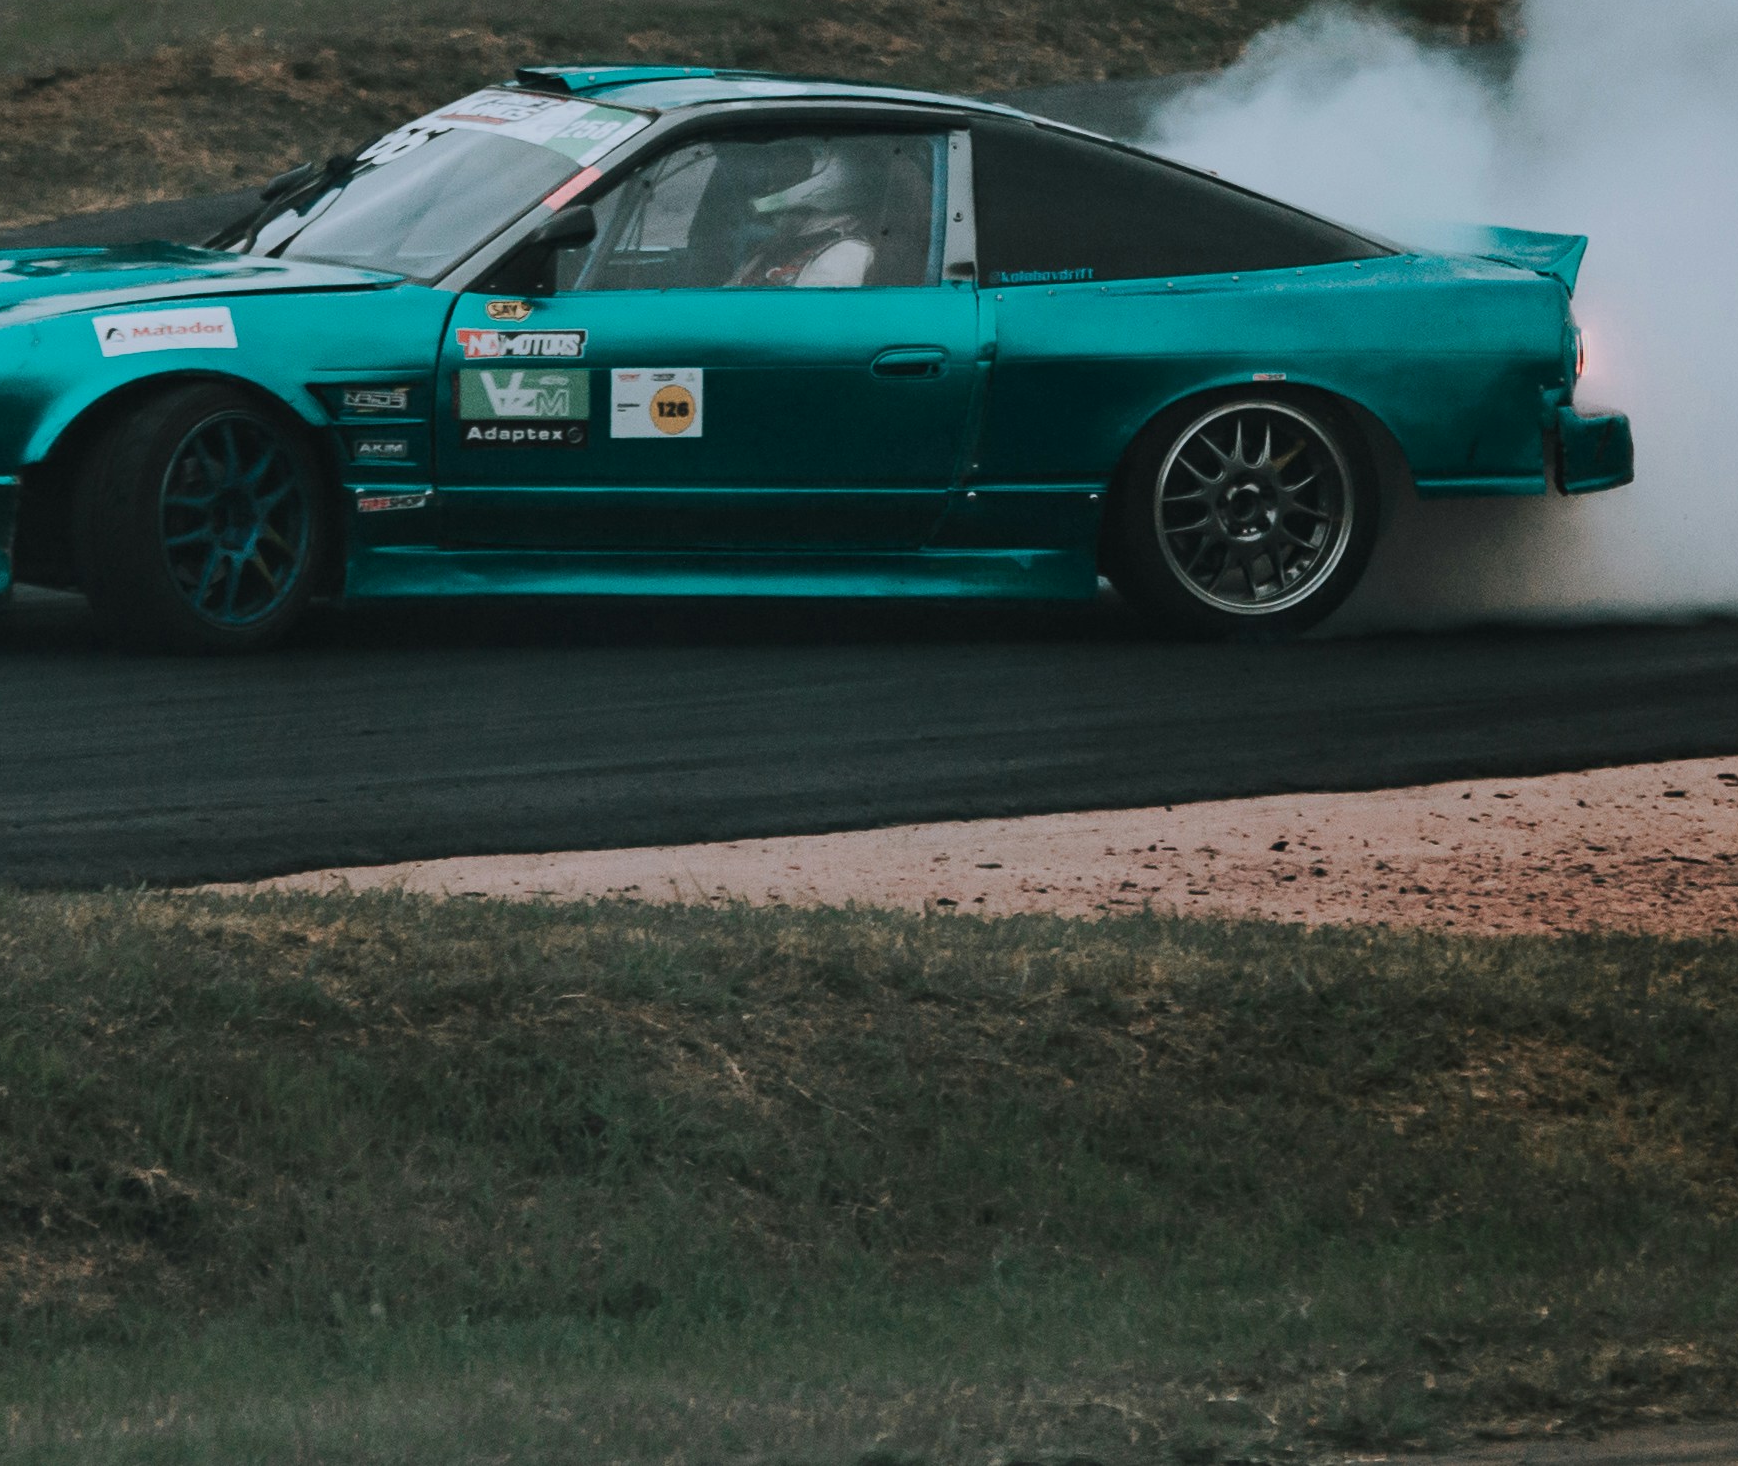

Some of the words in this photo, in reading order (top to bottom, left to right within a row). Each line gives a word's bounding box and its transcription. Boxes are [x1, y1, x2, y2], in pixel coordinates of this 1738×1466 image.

[557, 118, 622, 141] 258
[131, 321, 225, 338] Matador
[656, 401, 690, 418] 126
[465, 425, 565, 444] Adaptex
